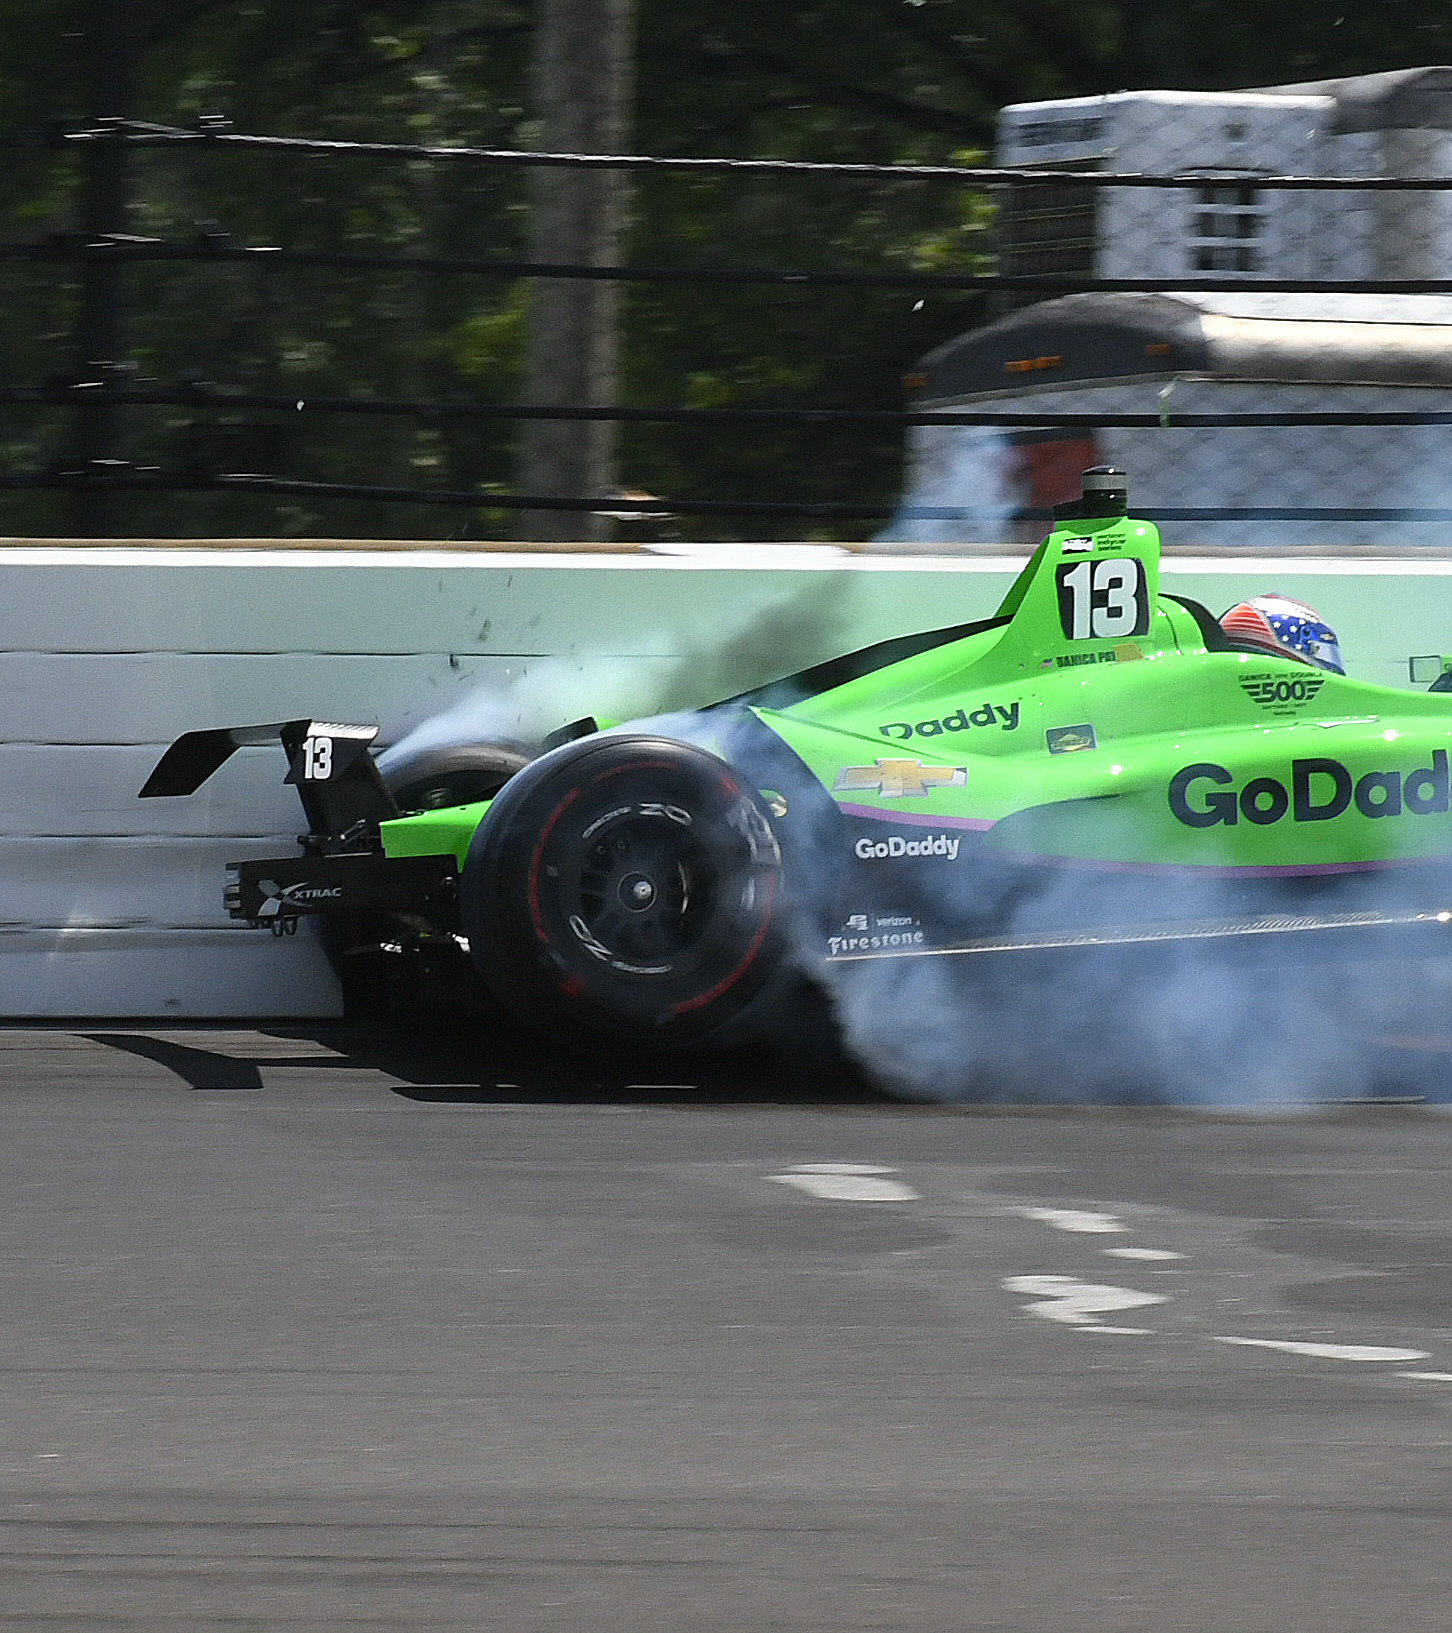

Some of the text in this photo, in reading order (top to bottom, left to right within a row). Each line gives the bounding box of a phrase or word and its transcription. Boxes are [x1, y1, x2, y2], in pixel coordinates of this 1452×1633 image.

[1063, 558, 1138, 640] 13
[1056, 653, 1097, 668] DANICA
[1254, 680, 1306, 704] 500
[302, 737, 333, 780] 13
[855, 834, 960, 861] GoDaddy
[876, 916, 912, 927] verizon
[827, 930, 924, 956] Firestone
